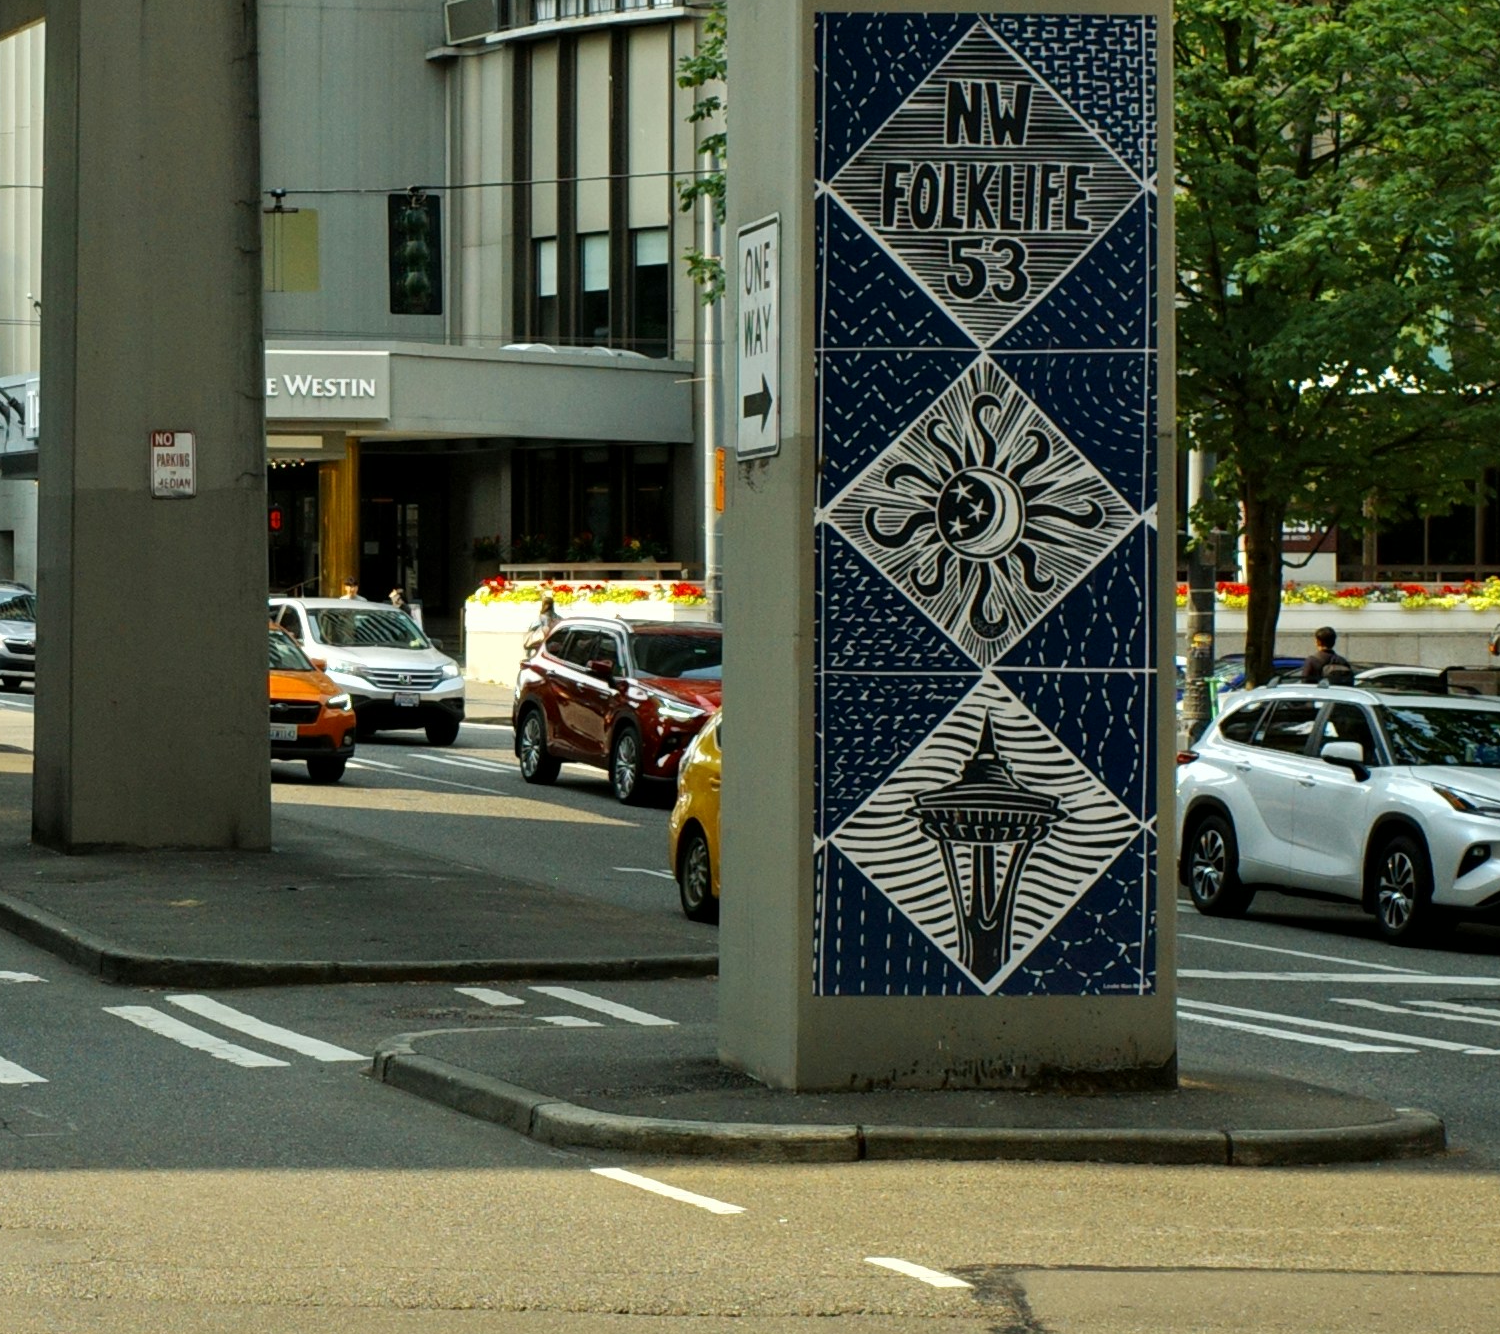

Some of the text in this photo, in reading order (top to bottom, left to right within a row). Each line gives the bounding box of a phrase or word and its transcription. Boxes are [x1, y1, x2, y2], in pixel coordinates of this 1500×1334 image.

[945, 81, 1032, 146] NW
[881, 161, 1092, 231] FOLKLIFE
[744, 241, 772, 296] ONE
[944, 237, 1029, 303] 53
[743, 306, 772, 358] WAY
[282, 374, 376, 397] WESTIN
[155, 432, 173, 446] NO
[156, 452, 190, 468] PARKING
